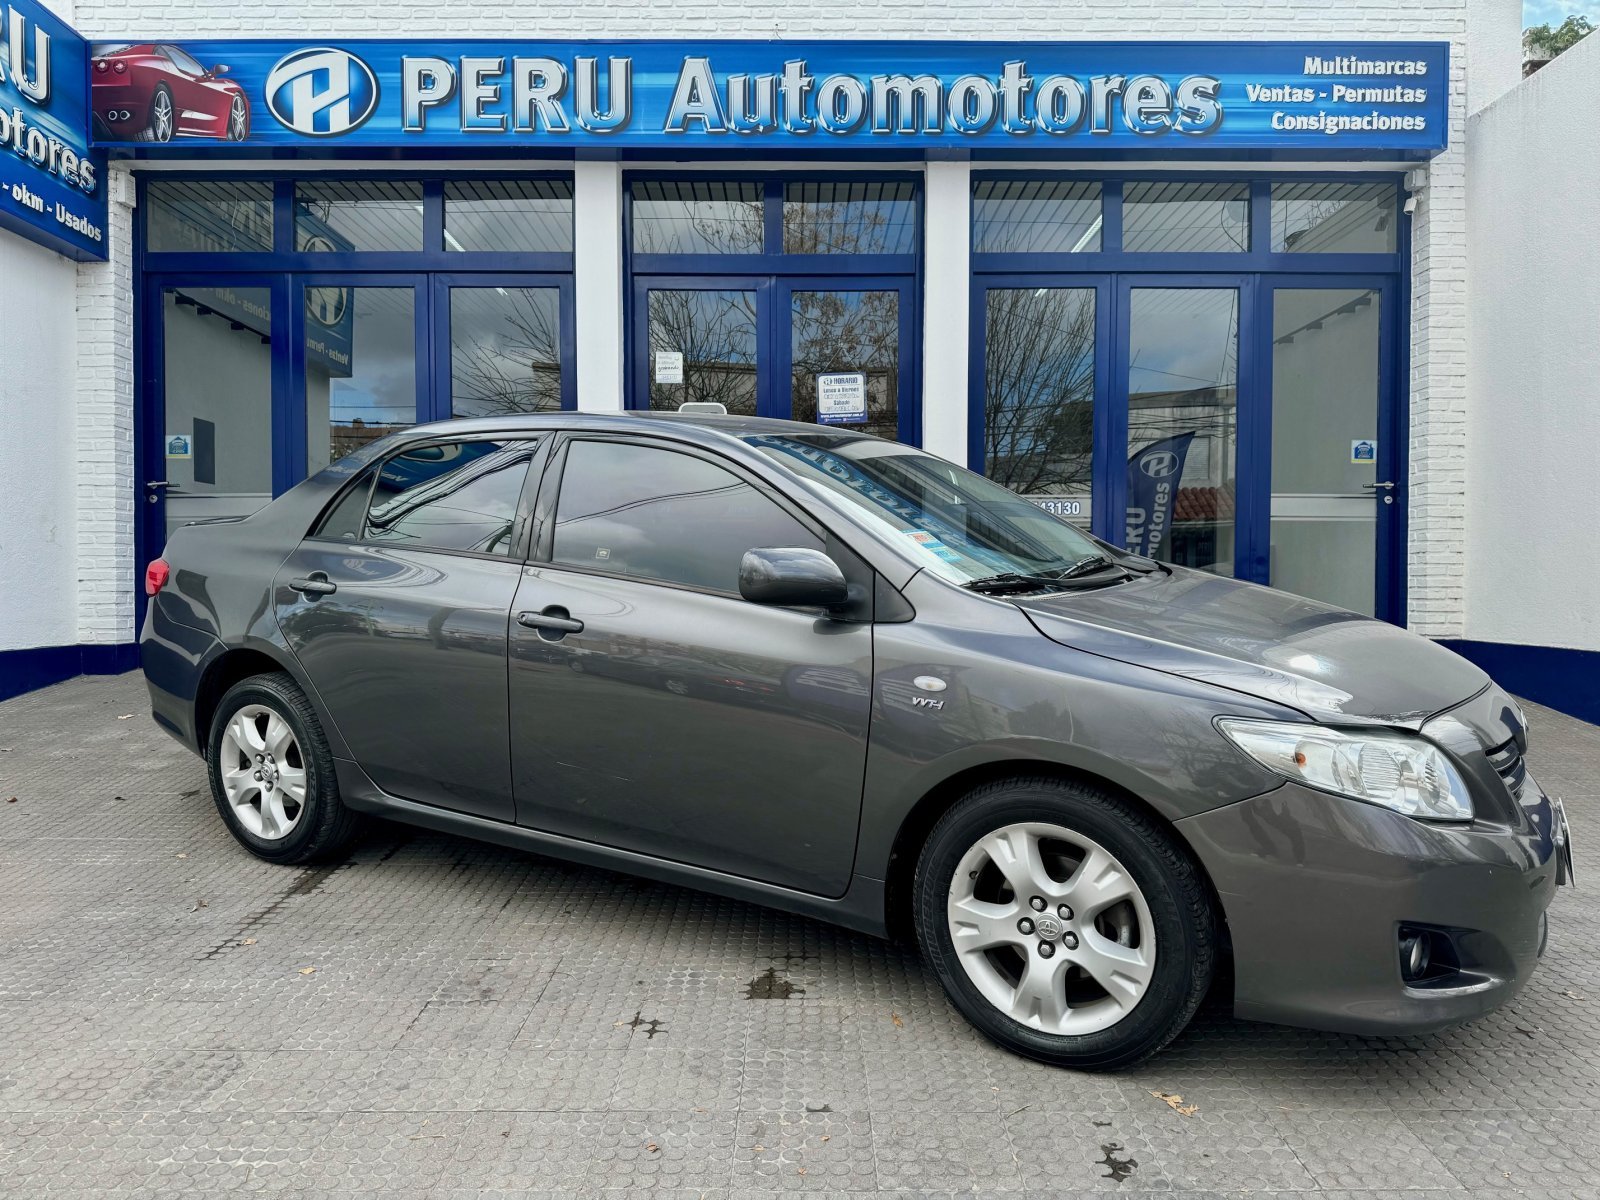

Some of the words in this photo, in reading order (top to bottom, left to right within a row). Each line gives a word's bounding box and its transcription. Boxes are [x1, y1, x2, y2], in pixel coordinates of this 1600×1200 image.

[1303, 56, 1427, 75] Multimarcas
[401, 55, 633, 134] PERU
[664, 56, 1223, 135] Automotores
[1246, 84, 1315, 103] Ventas
[1332, 84, 1427, 103] Permutas
[1271, 111, 1426, 134] Consignaciones
[55, 201, 102, 242] Usados
[1032, 500, 1081, 515] 43130
